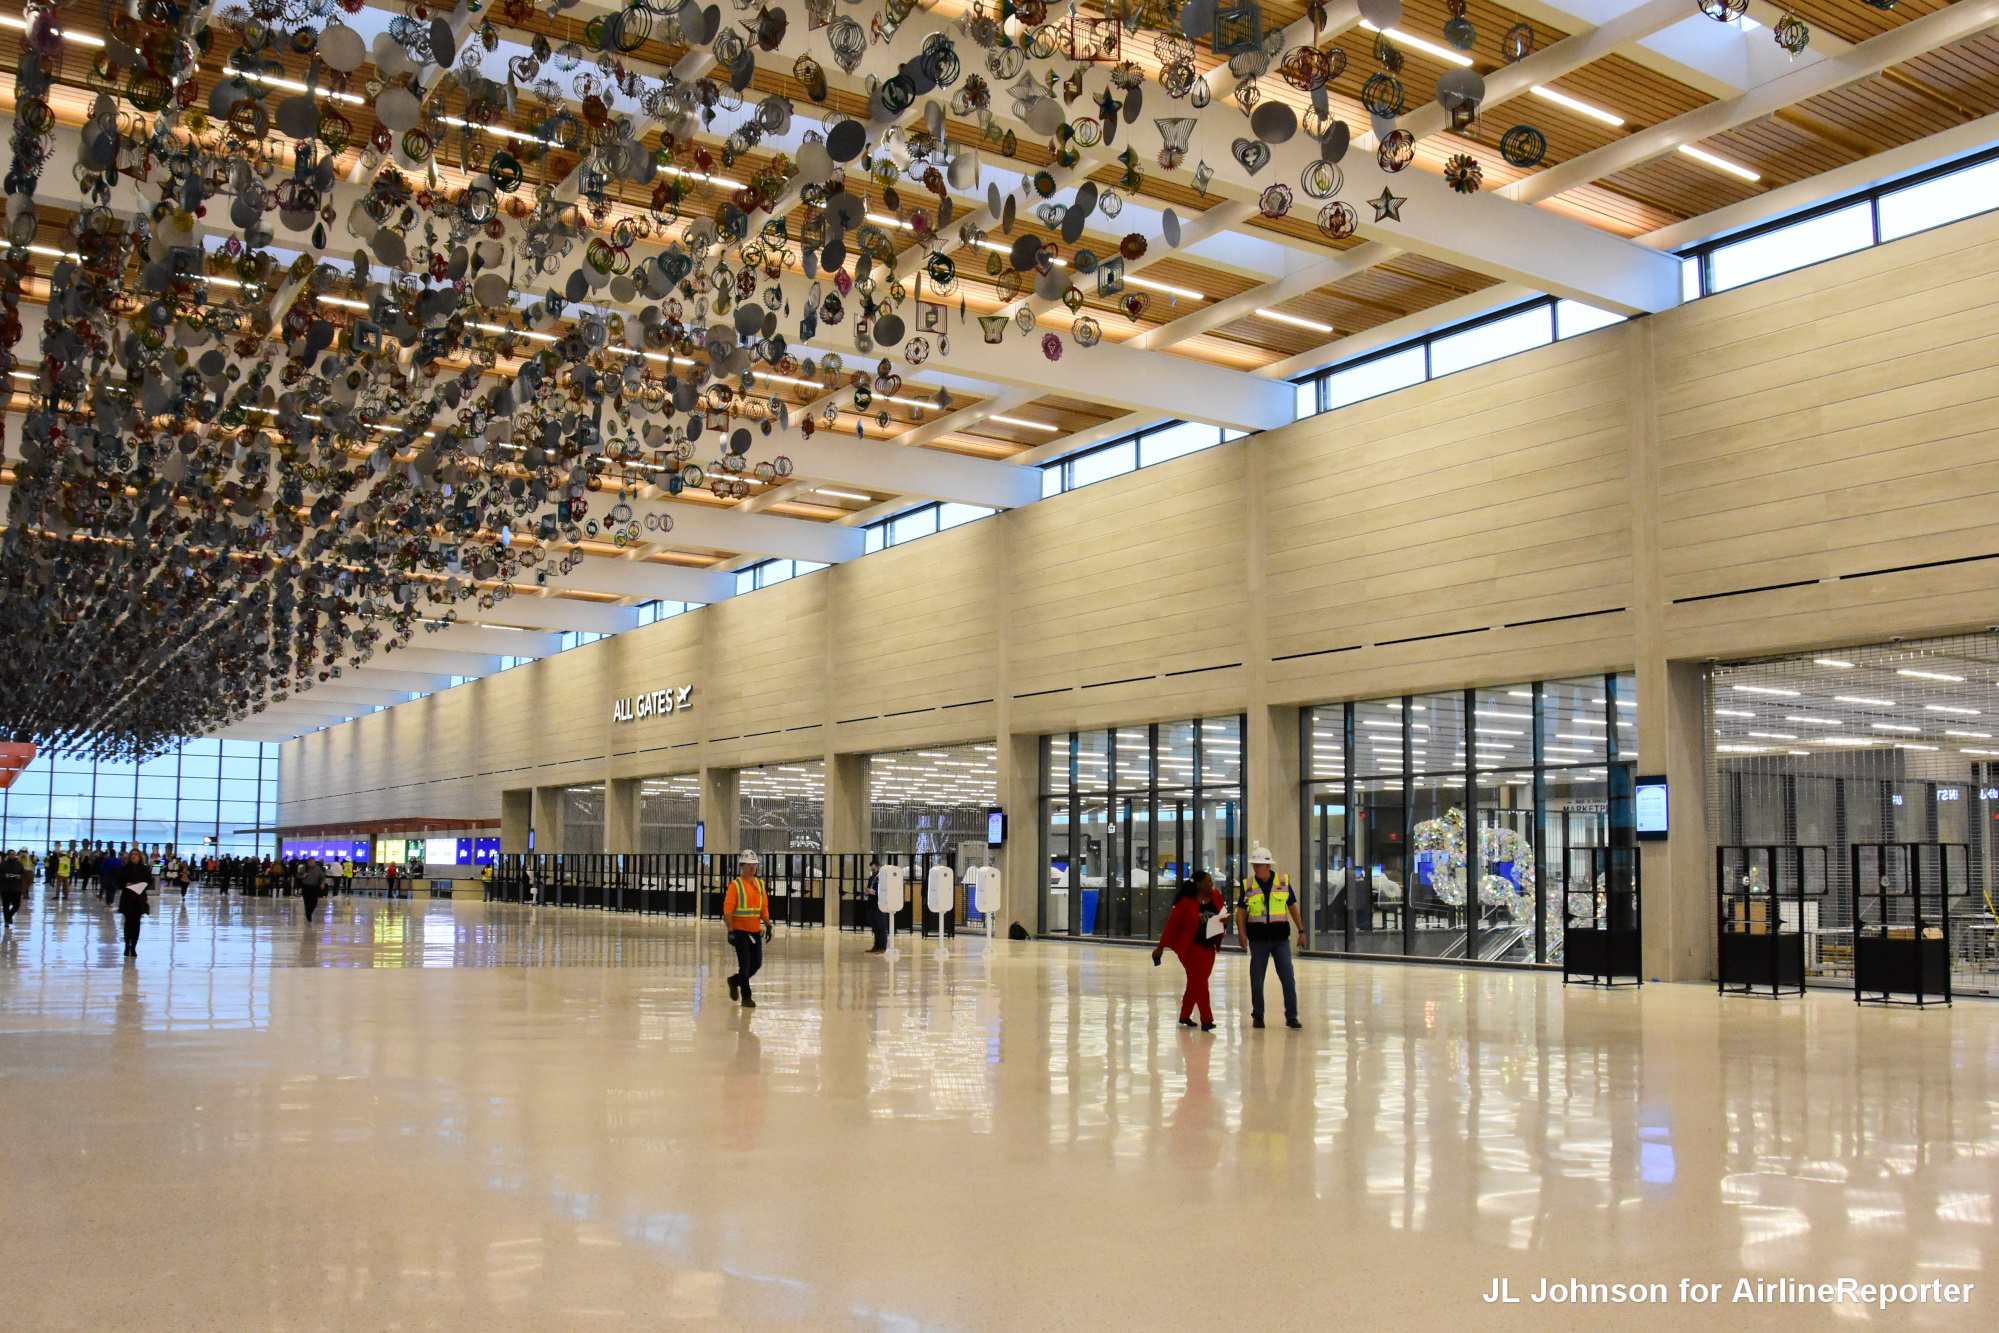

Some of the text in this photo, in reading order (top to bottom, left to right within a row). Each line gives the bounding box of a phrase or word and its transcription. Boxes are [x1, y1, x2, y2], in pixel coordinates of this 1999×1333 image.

[613, 688, 674, 722] ALL GATES
[1563, 804, 1608, 813] MARKETP
